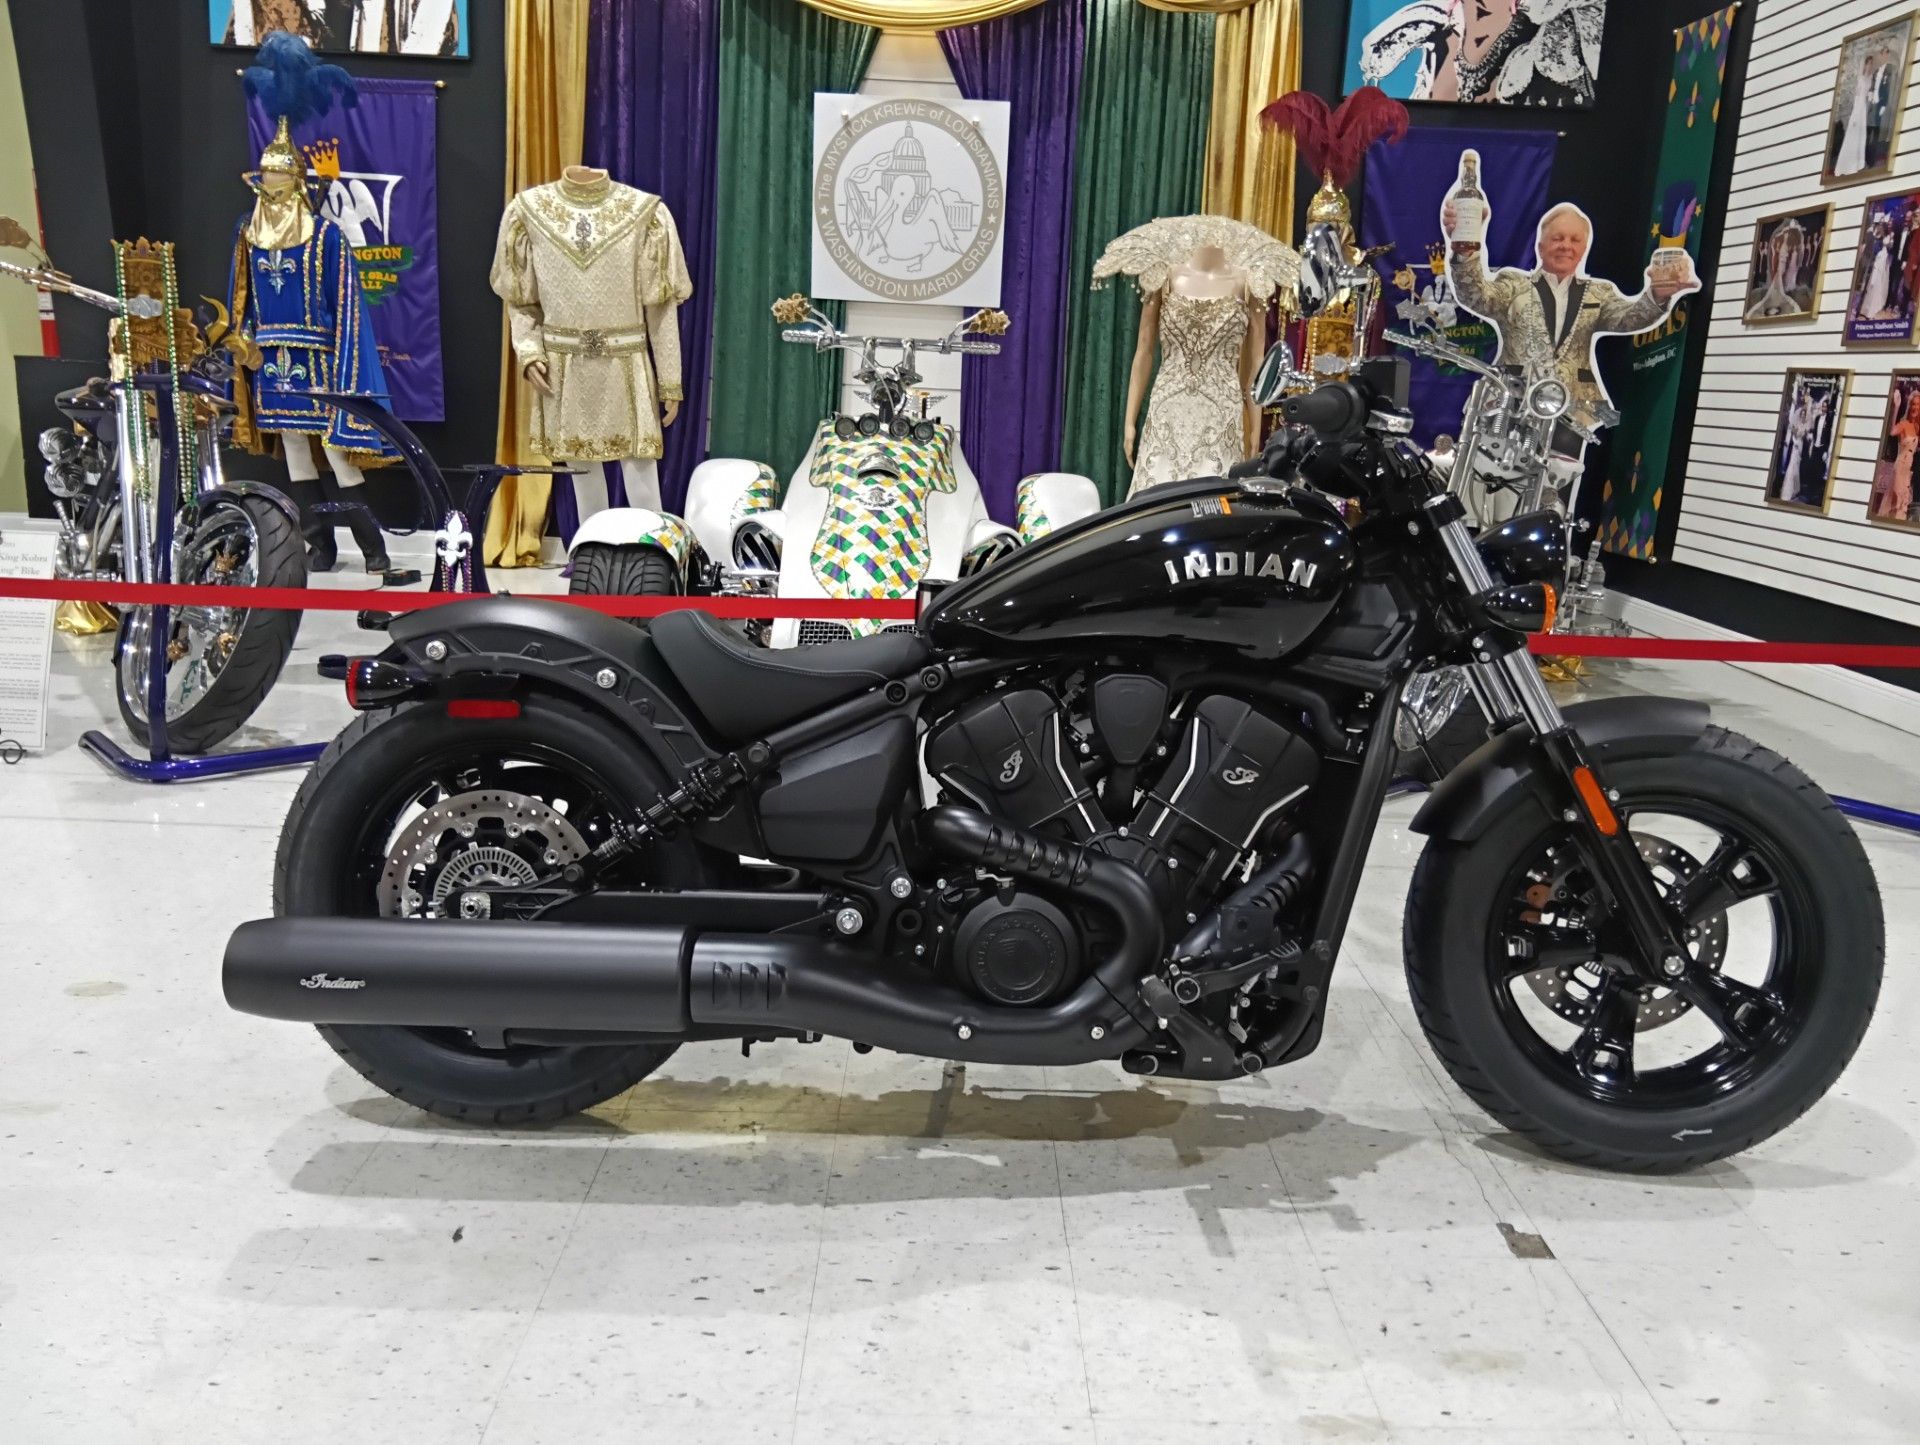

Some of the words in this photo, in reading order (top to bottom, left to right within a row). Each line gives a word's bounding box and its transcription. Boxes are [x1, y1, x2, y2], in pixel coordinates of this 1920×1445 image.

[873, 102, 927, 120] KREWE
[929, 109, 945, 121] of
[823, 113, 873, 170] MYSTICK
[944, 114, 1000, 209] LOUISIANIANS
[818, 173, 833, 200] The
[353, 247, 402, 261] NGTON
[821, 220, 908, 297] WASHINGTON
[912, 269, 963, 297] MARDI
[961, 228, 994, 272] GRAS
[1164, 552, 1318, 589] INDIAN
[300, 973, 366, 989] Indian
